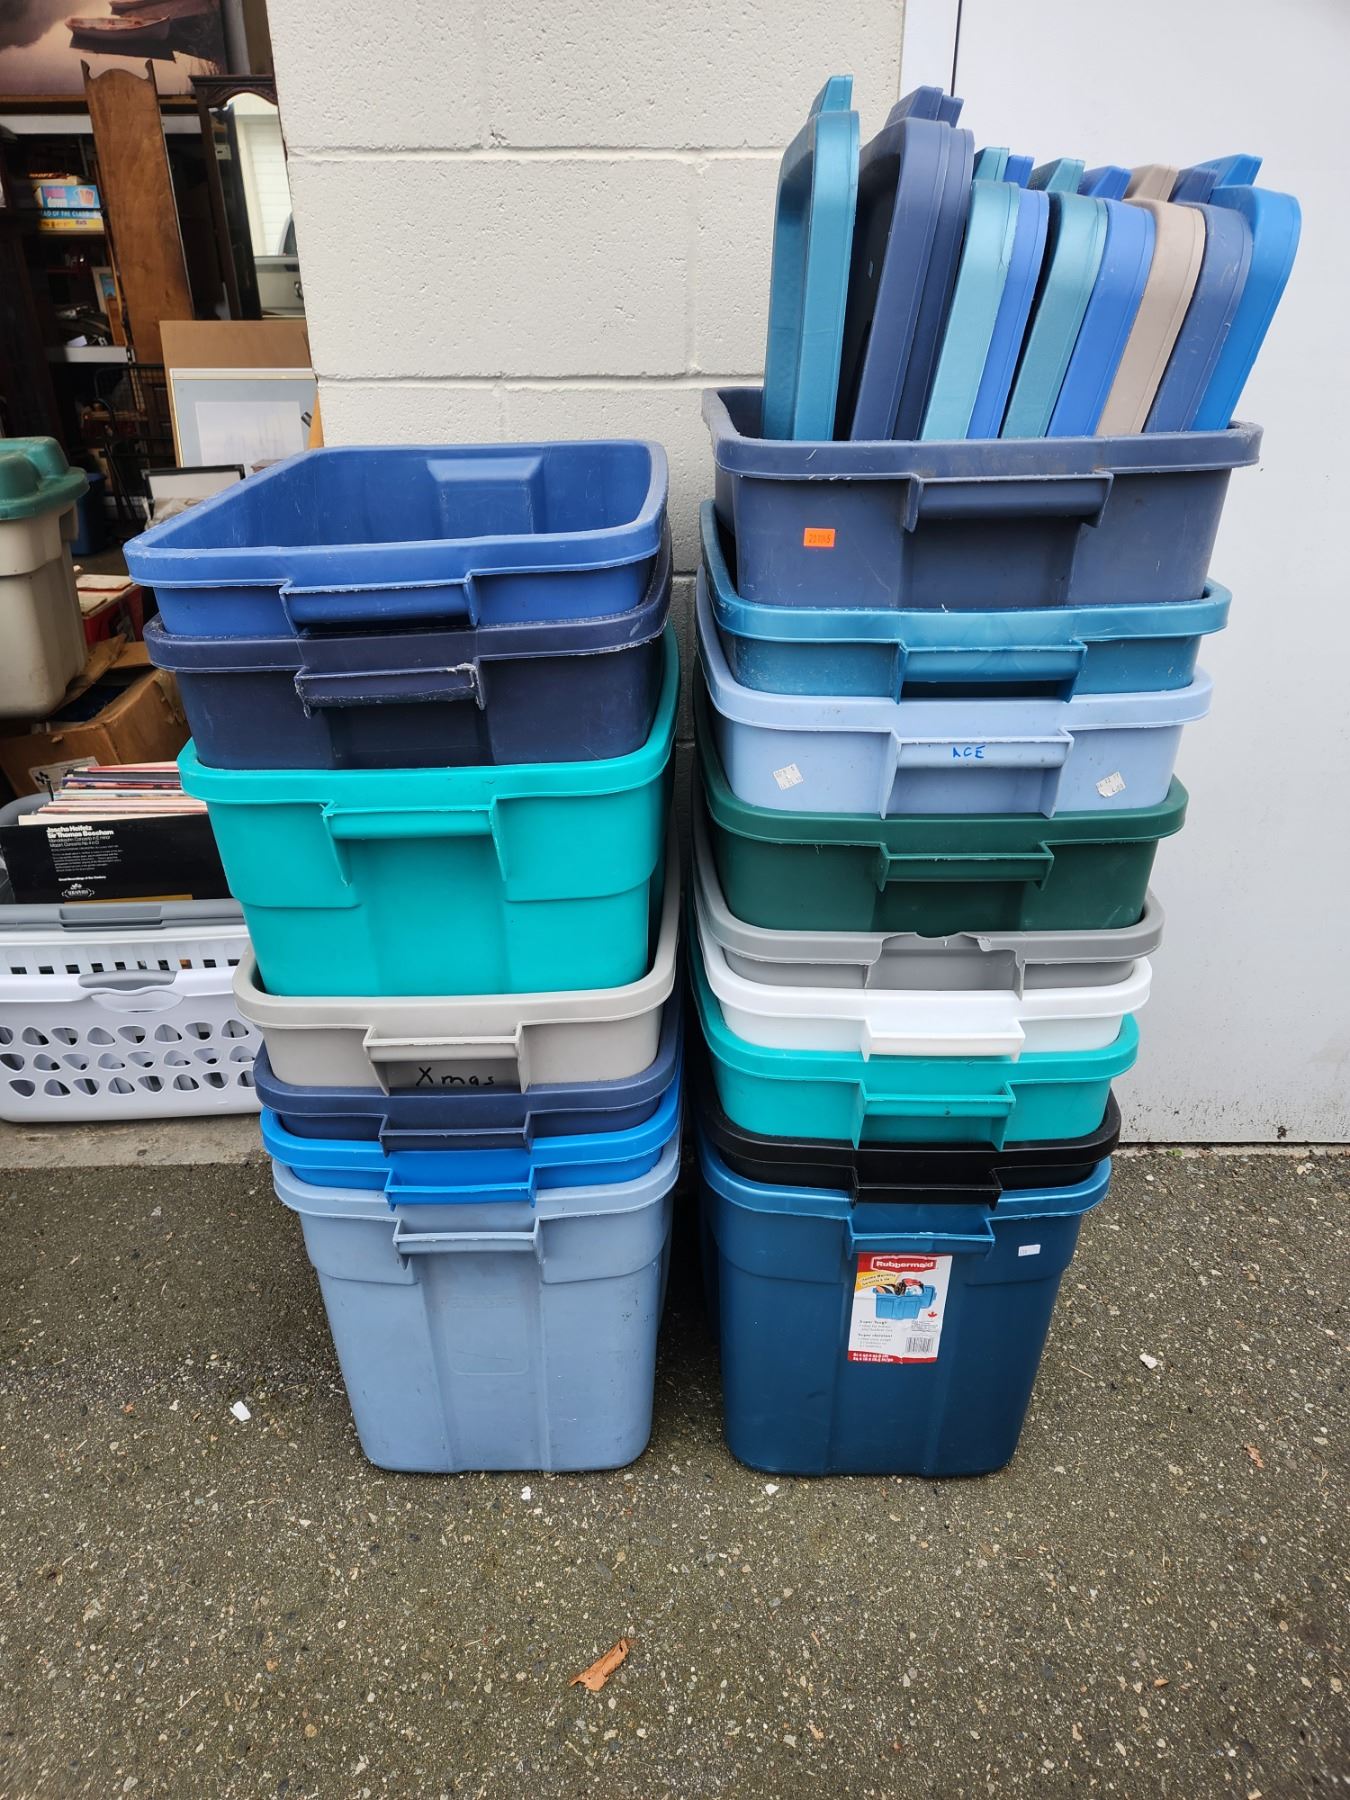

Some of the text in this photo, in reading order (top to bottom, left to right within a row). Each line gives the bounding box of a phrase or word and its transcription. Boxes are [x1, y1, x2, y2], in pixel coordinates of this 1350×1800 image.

[952, 745, 986, 759] ACE
[416, 1066, 495, 1087] Xmas
[876, 1261, 934, 1269] Rubbermaid
